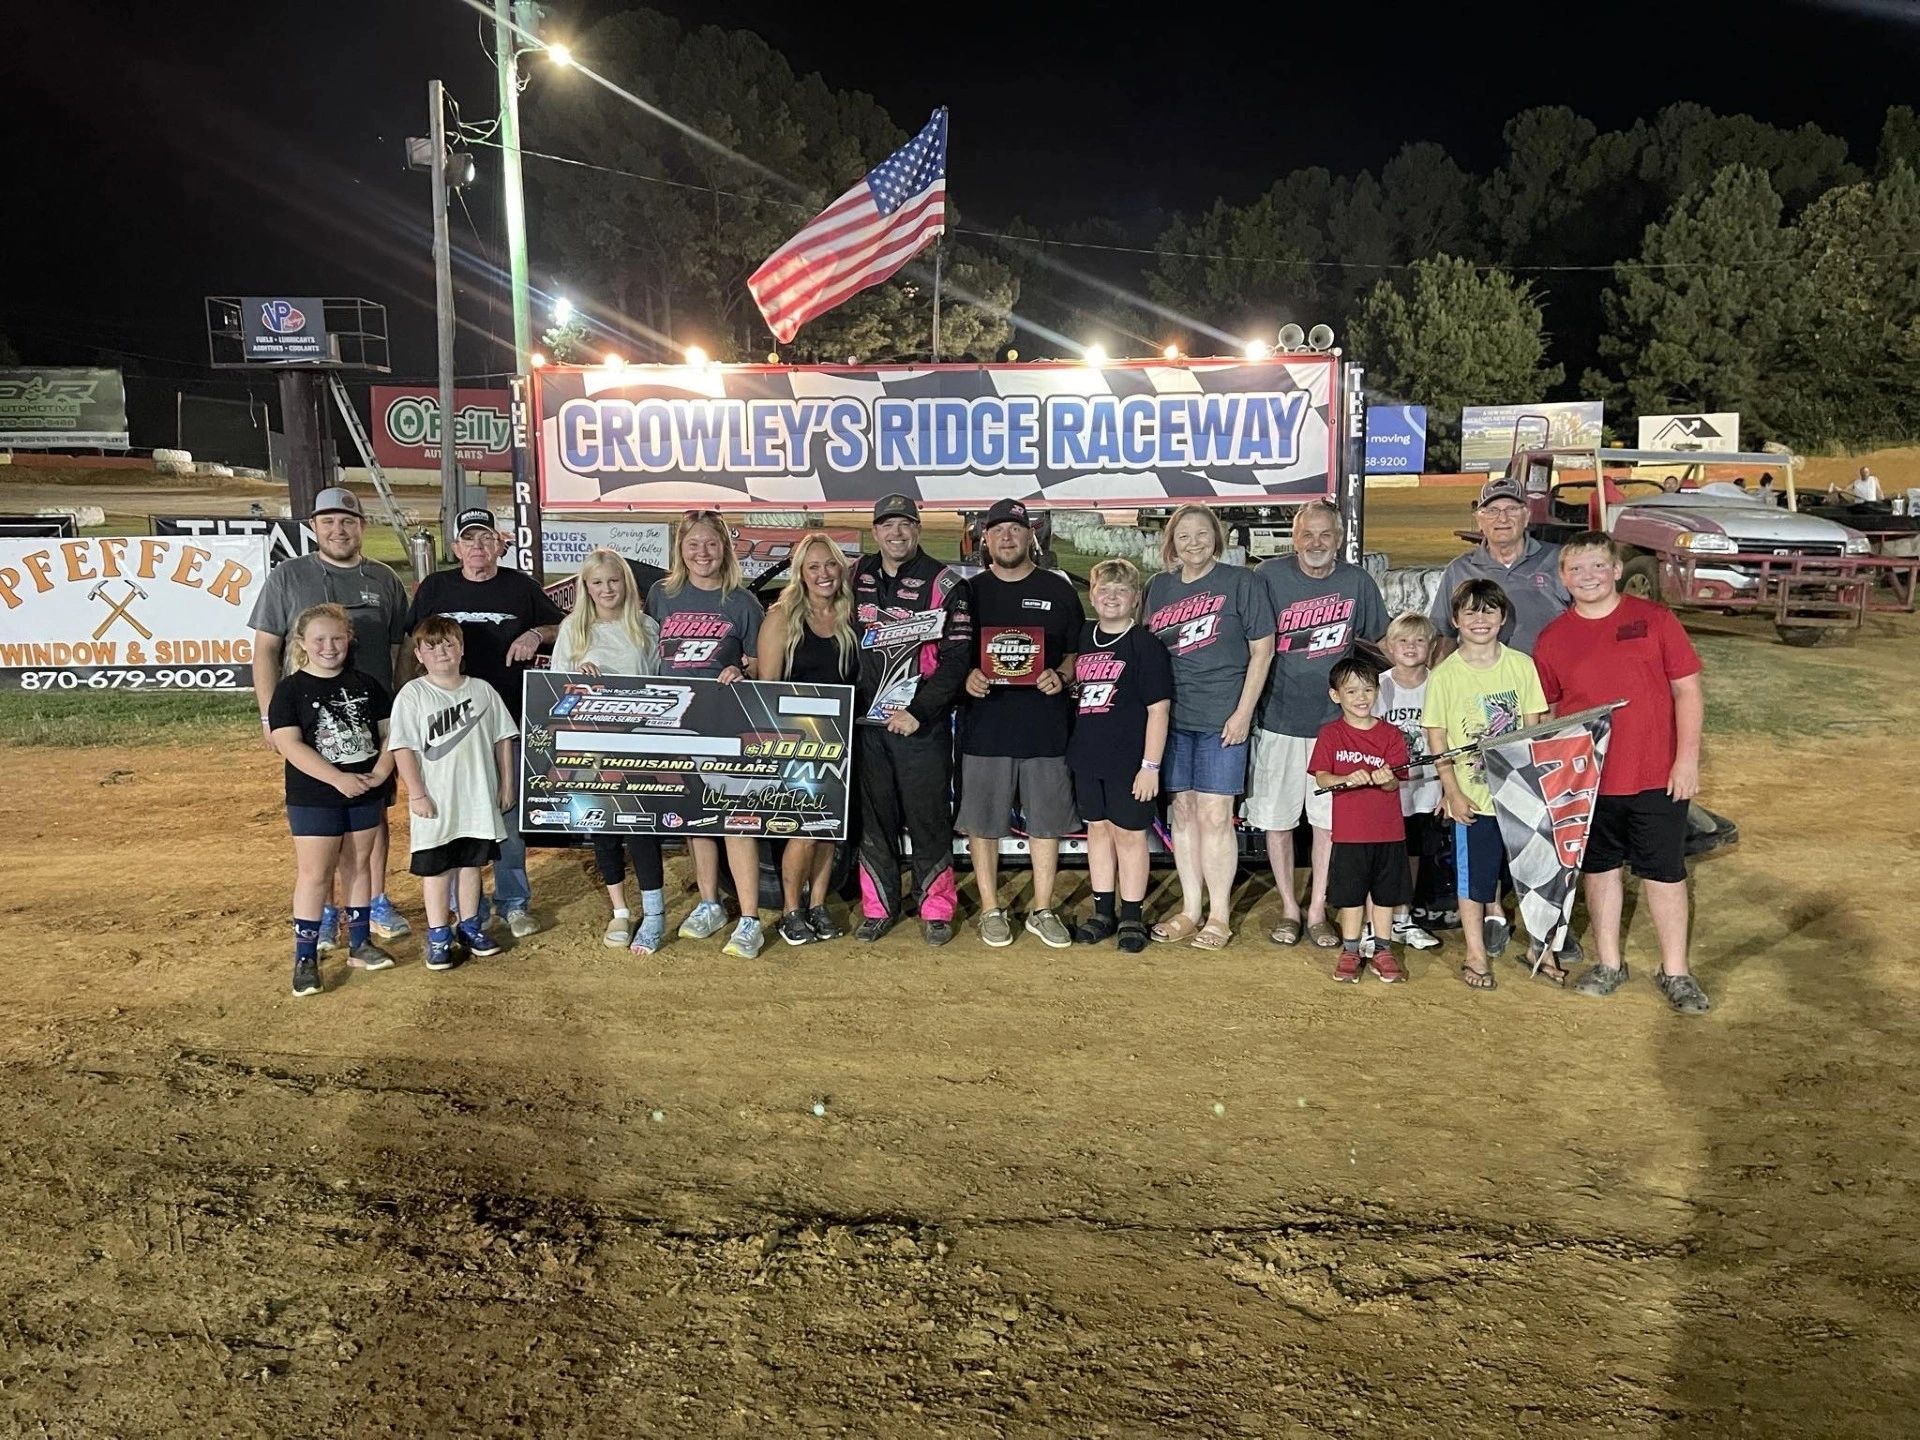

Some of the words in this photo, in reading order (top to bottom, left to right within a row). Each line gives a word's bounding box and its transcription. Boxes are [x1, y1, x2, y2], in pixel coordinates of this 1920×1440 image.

[262, 301, 292, 332] VP
[0, 404, 77, 413] UTOMOTIVE
[510, 379, 527, 448] THE
[387, 398, 511, 452] O'Reilly
[560, 398, 870, 473] CROWLEY'S
[874, 396, 1040, 471] RIDGE
[1046, 391, 1311, 470] RACEWAY
[1371, 433, 1411, 446] moving
[424, 449, 442, 459] AUT
[456, 450, 483, 460] ARTS
[515, 481, 534, 575] RIDG
[609, 527, 643, 541] Serving
[542, 542, 598, 553] ECTRICA
[545, 552, 586, 563] ERVIC
[0, 538, 253, 609] PFEFFER
[878, 622, 933, 641] LEGENDS
[1178, 614, 1216, 648] 33
[1308, 623, 1347, 652] 33
[1, 641, 117, 667] WINDOW
[126, 641, 148, 665] &
[155, 639, 252, 665] SIDING
[674, 641, 719, 662] 33
[986, 643, 1041, 654] RIDGE
[21, 669, 237, 690] 870-679-9002
[1079, 684, 1114, 708] 33
[578, 700, 668, 716] LEGENDS
[1385, 708, 1422, 722] USTA
[427, 698, 475, 741] NIKE
[745, 740, 844, 760] $1000
[555, 756, 594, 766] ONE
[602, 758, 695, 770] THOUSAND
[701, 761, 779, 773] DOLLARS
[527, 774, 552, 789] For
[555, 781, 621, 791] FEATURE
[626, 782, 685, 793] WINNER
